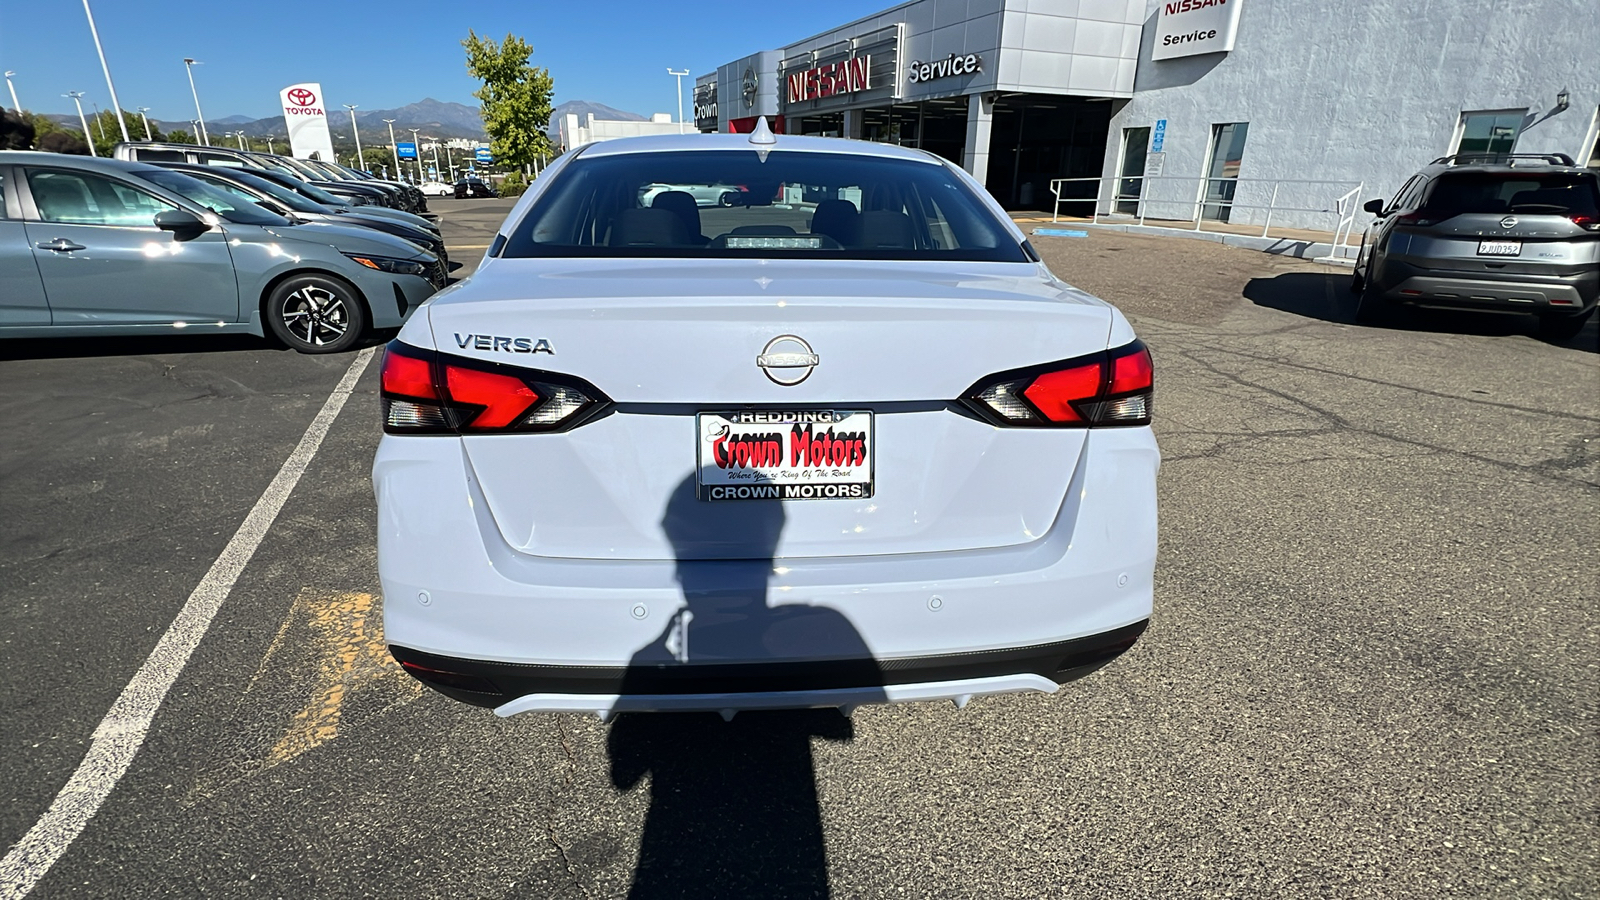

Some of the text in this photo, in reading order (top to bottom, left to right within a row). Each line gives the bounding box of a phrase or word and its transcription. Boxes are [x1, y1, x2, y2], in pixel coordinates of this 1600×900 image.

[1162, 29, 1217, 46] Service
[909, 53, 977, 84] Service
[787, 55, 871, 104] NISSAN
[285, 107, 324, 117] TOYOTA
[694, 102, 718, 120] Crown
[454, 332, 556, 356] VERSA
[757, 355, 819, 365] NISSAN
[740, 411, 833, 423] REDDING
[712, 423, 866, 469] Crown Motors
[727, 469, 852, 482] Where You're King Of The Road
[711, 484, 862, 499] CROWN MOTORS
